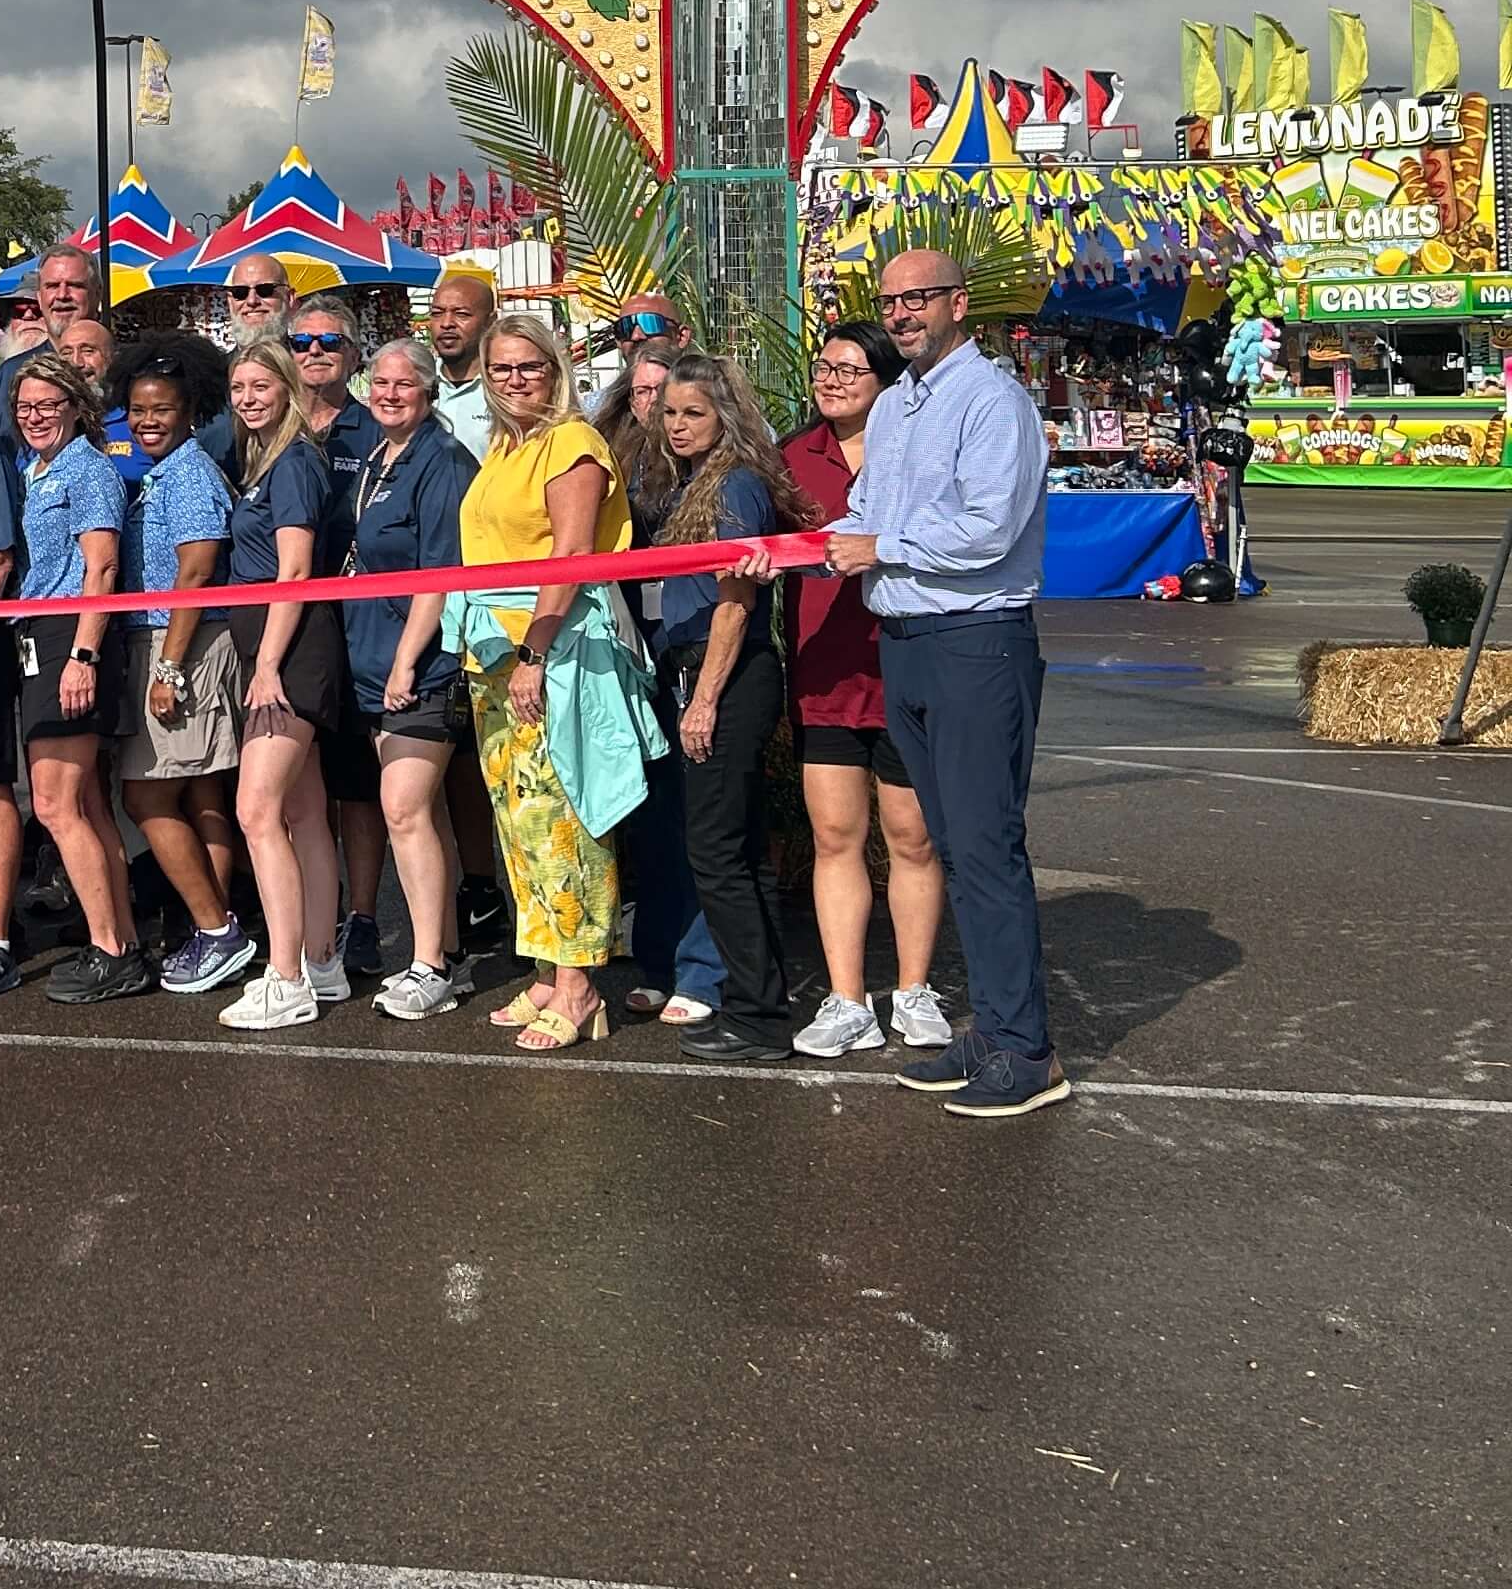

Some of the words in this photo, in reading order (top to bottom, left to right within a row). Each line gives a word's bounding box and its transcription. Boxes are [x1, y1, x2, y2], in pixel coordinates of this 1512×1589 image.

[1210, 90, 1465, 159] LEMONADE
[1288, 209, 1344, 242] NEL
[1344, 203, 1443, 240] CAKES
[1319, 282, 1433, 312] CAKES
[1480, 284, 1512, 304] NA
[1301, 428, 1382, 452] CORNDOGS
[1414, 443, 1471, 462] NACHOS
